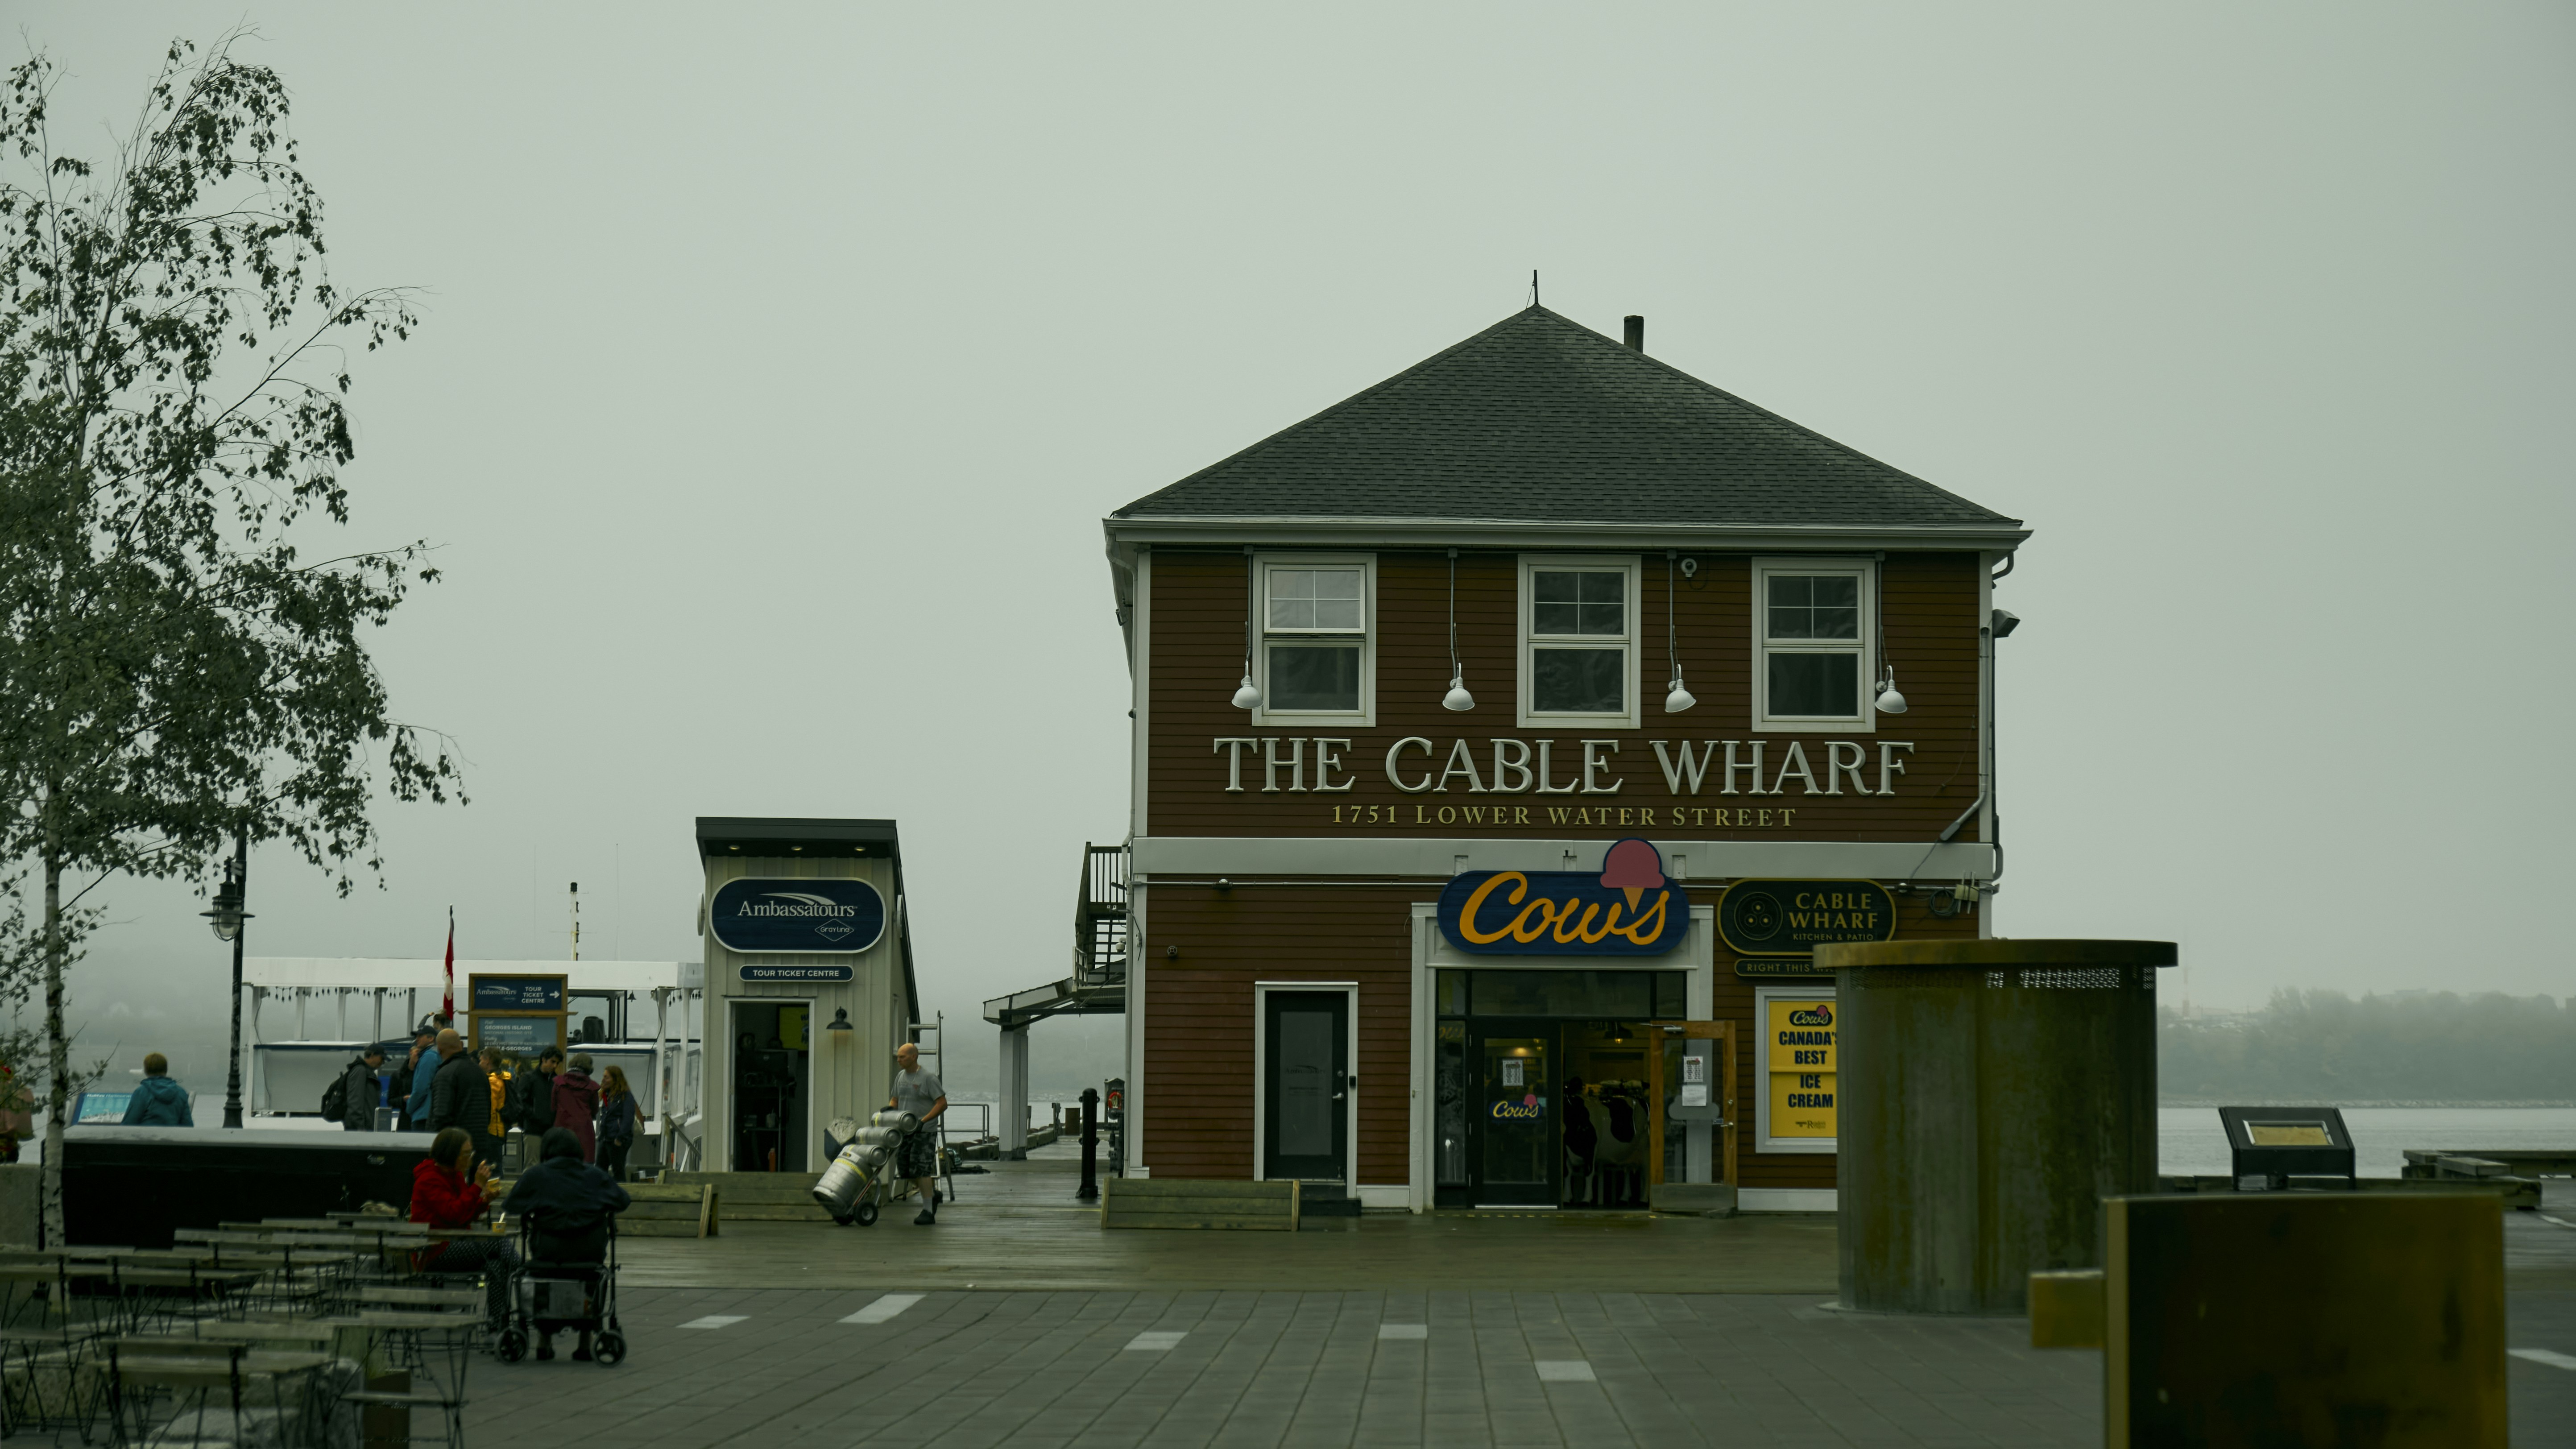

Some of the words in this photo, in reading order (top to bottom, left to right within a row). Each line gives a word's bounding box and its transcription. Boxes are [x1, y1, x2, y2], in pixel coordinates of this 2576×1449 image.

[1213, 737, 1356, 792] THE
[1385, 737, 1623, 794] CABLE
[1648, 740, 1915, 796] WHARF
[1332, 804, 1397, 824] 1751
[1415, 805, 1531, 824] LOWER
[1546, 807, 1657, 826] WATER
[1673, 807, 1796, 827] STREET
[737, 900, 855, 917] Ambassatours
[1795, 893, 1872, 909] CABLE
[1789, 912, 1878, 929] WHARF
[1747, 963, 1781, 972] RIGHT
[1786, 964, 1810, 973] THIS
[1779, 1031, 1837, 1046] CANADA'
[1795, 1050, 1827, 1064] BEST
[1800, 1075, 1821, 1089] ICE
[1788, 1094, 1833, 1108] CREAM
